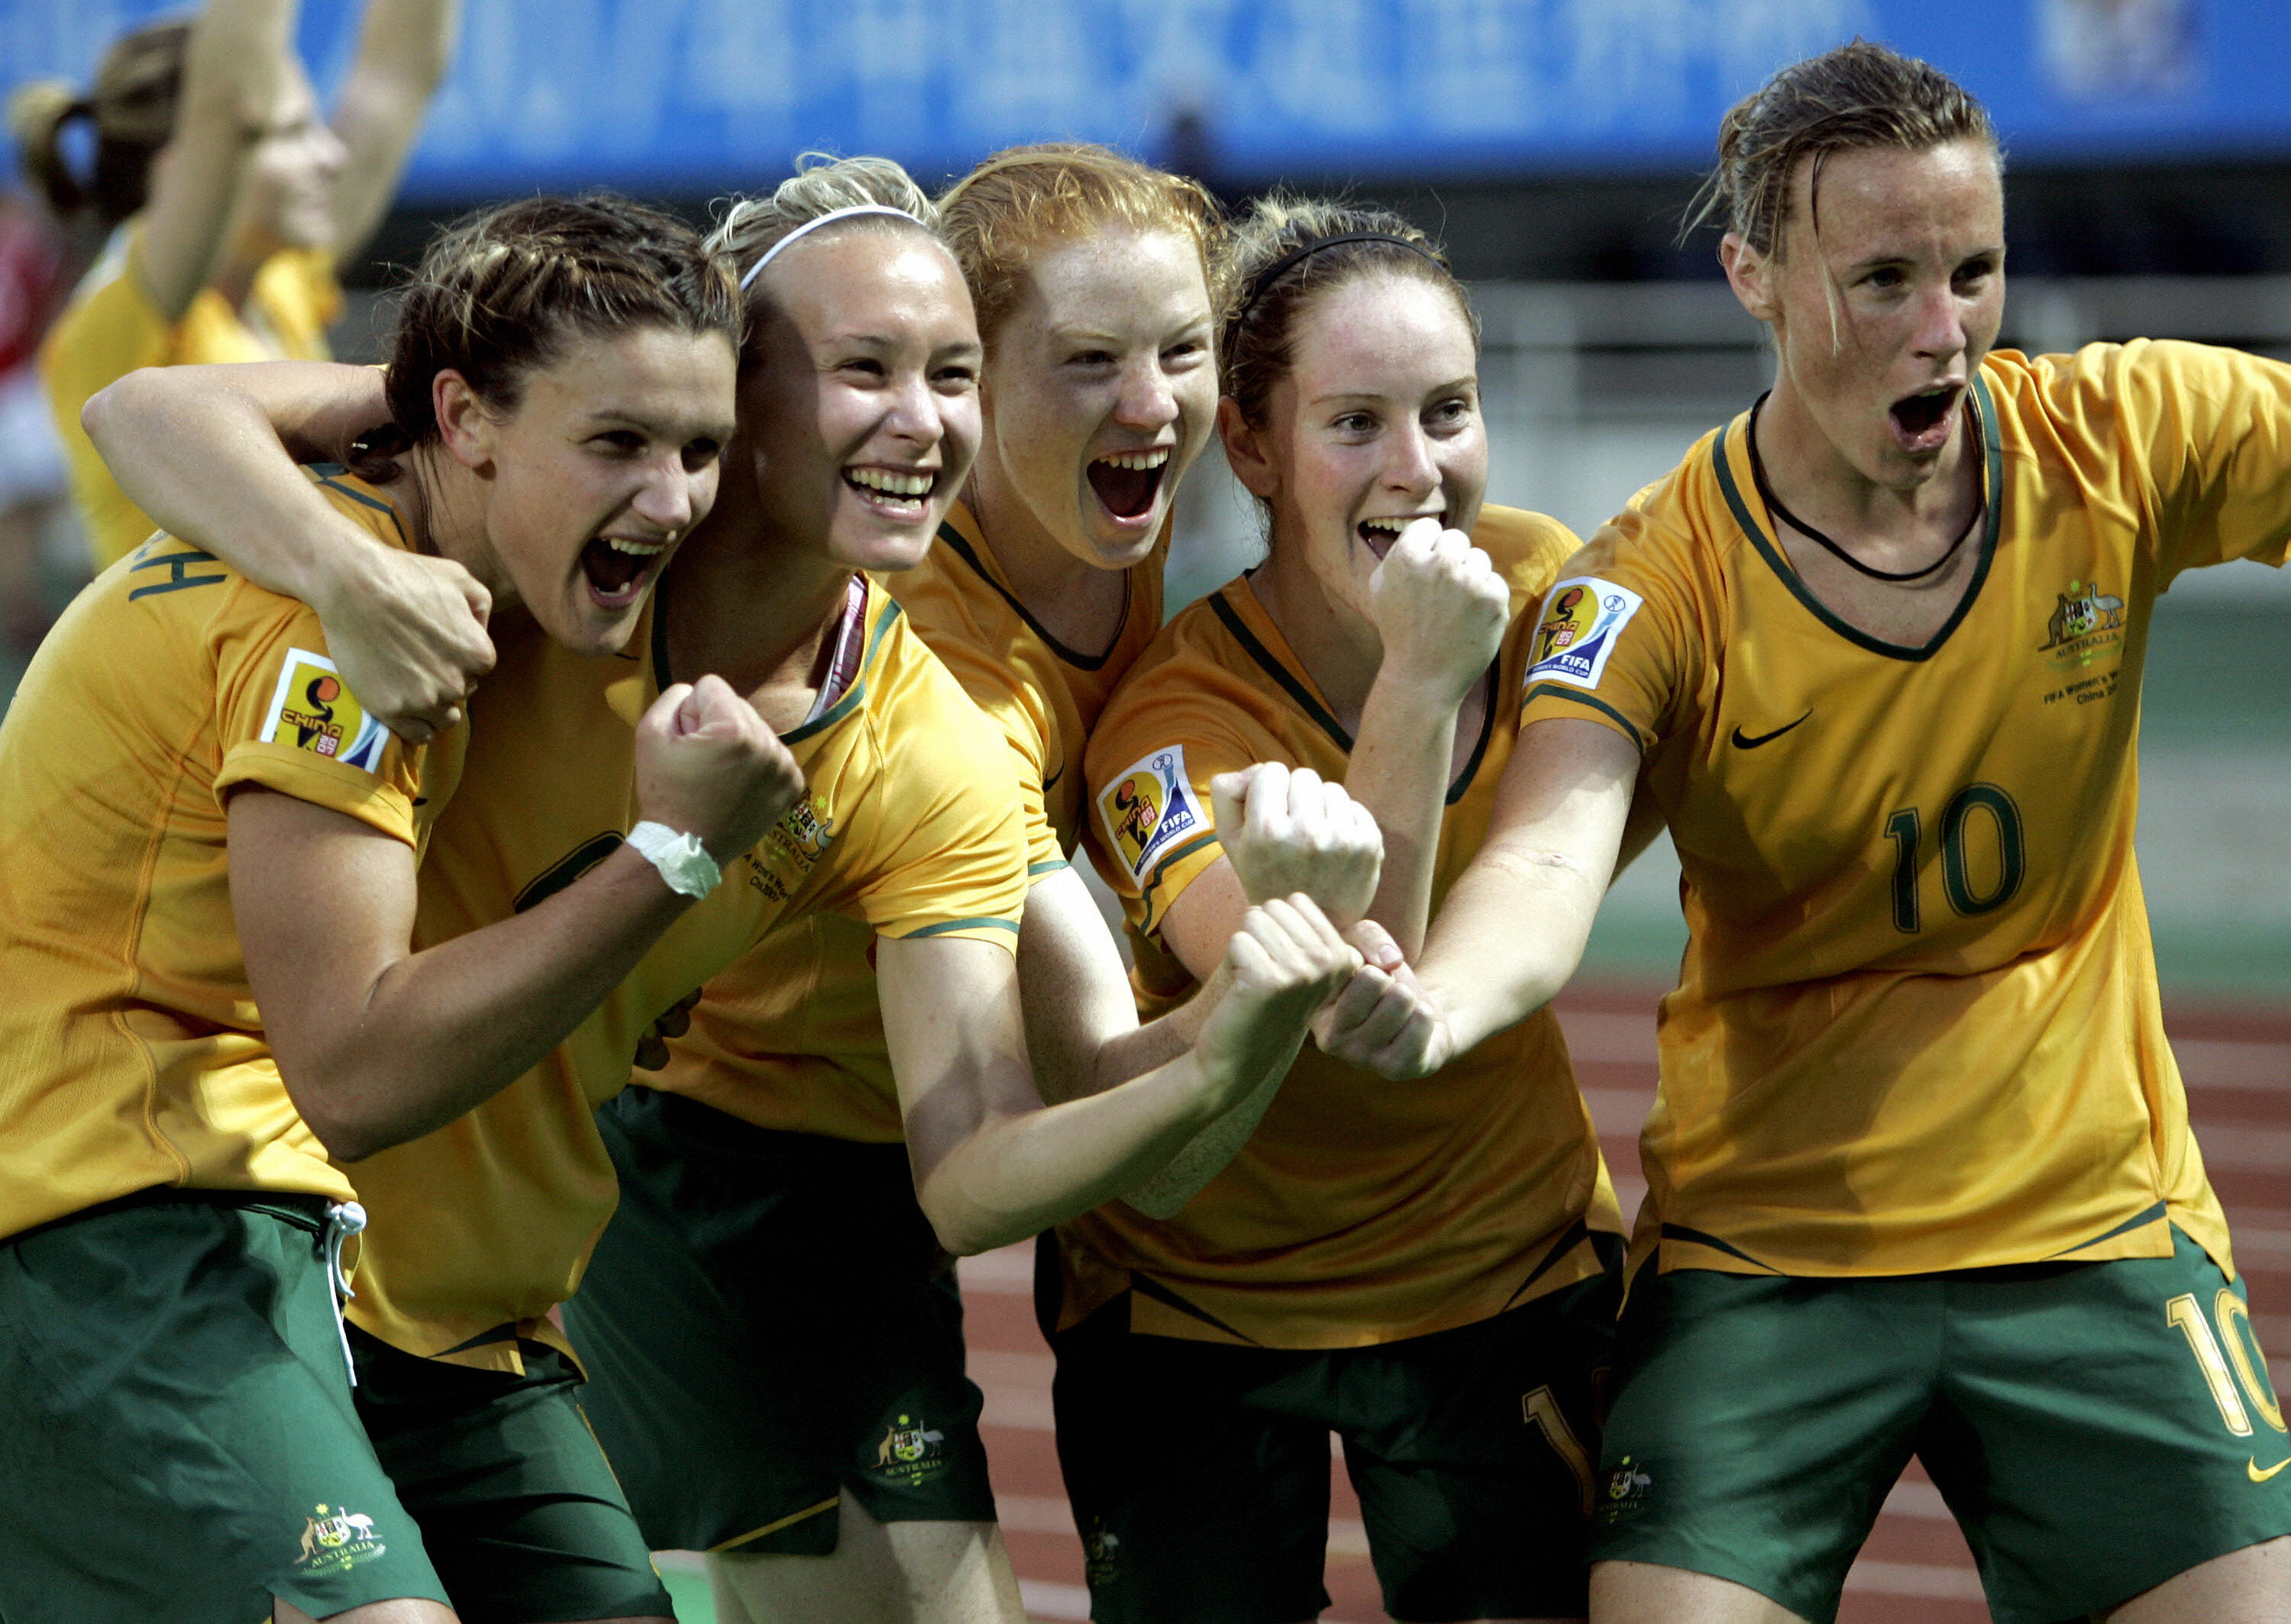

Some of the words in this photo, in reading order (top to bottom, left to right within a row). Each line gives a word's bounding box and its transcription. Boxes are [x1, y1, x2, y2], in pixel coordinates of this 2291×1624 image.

[2056, 631, 2118, 659] AUSTRALIA
[1560, 654, 1590, 672] FIFA
[2044, 689, 2063, 704] FIFA
[2077, 689, 2105, 705] China
[281, 709, 344, 739] CHINA
[1116, 795, 1151, 840] CHINA
[1161, 811, 1192, 833] FIFA
[1884, 782, 2026, 935] 10
[2166, 1287, 2288, 1437] 10
[885, 1458, 944, 1477] AUSTRALIA
[312, 1541, 376, 1568] AUSTRALIA
